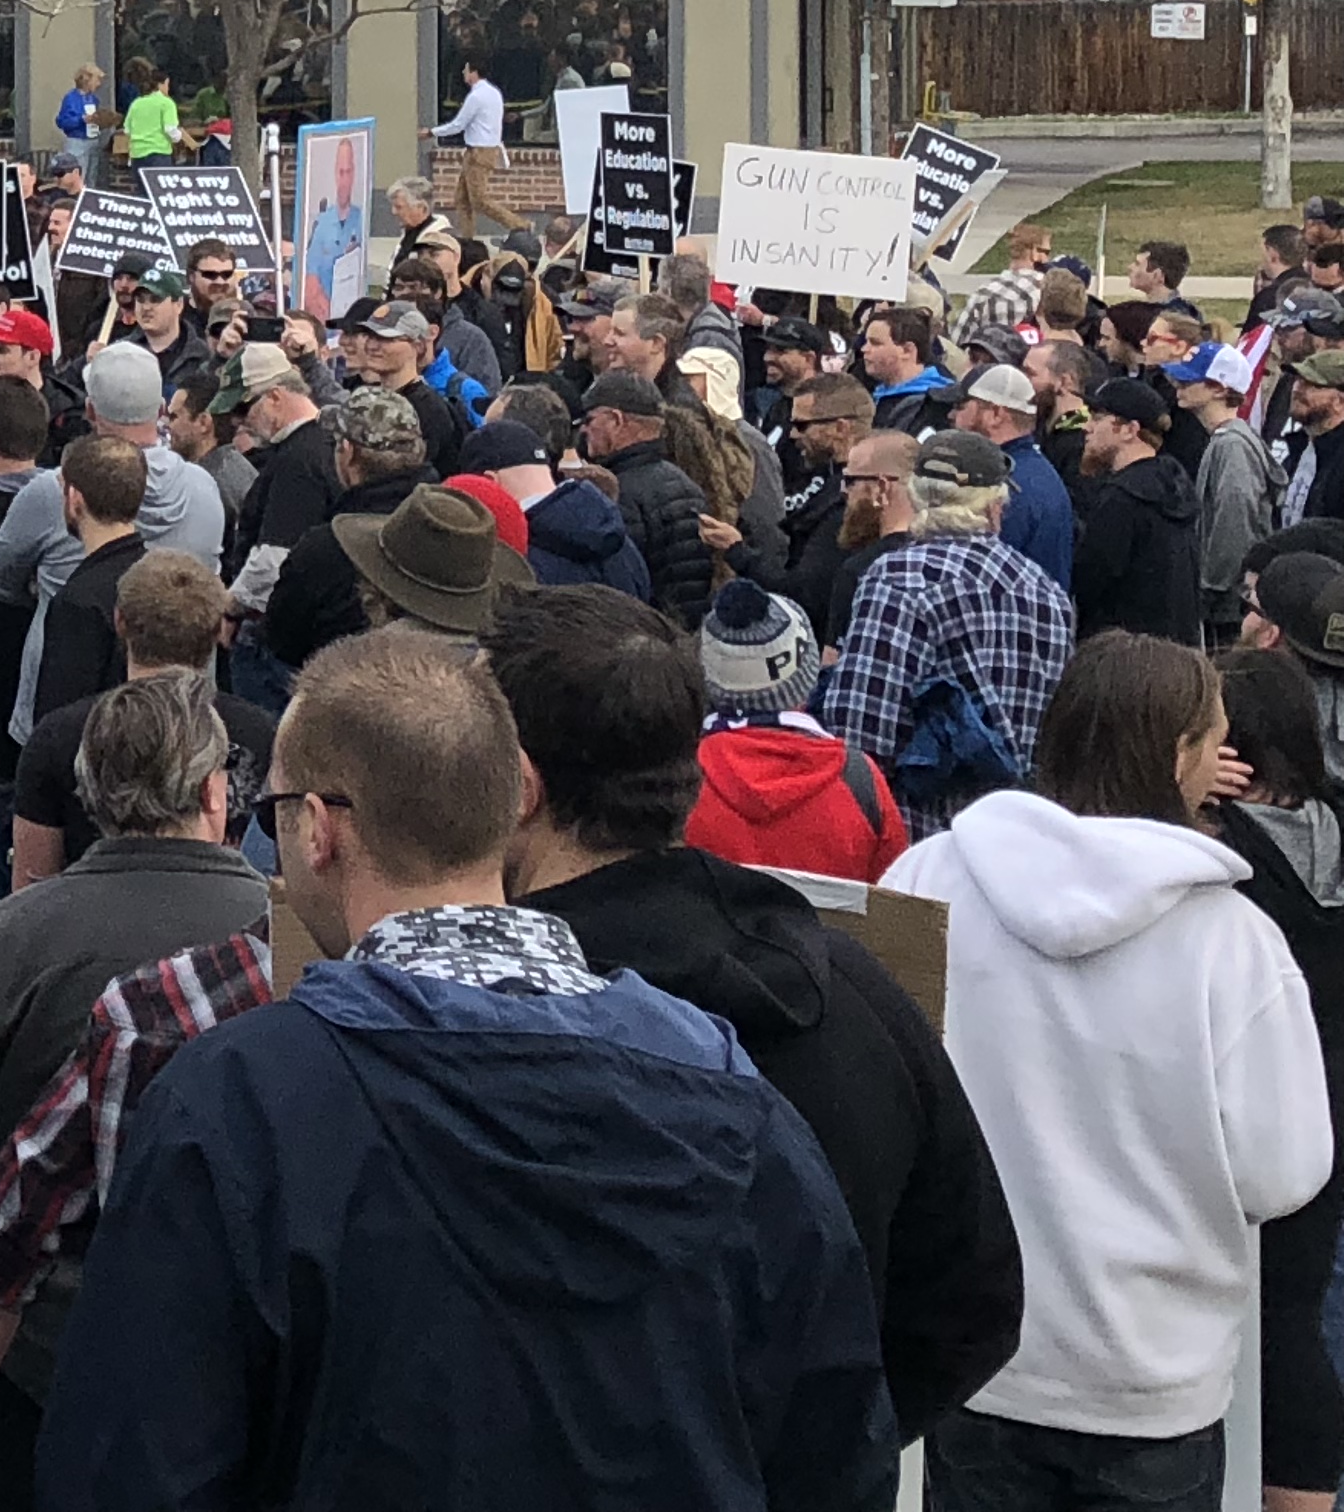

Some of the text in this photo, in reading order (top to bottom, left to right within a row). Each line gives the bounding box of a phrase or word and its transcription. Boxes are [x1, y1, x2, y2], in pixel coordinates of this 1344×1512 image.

[613, 120, 656, 143] More
[604, 149, 667, 173] Education
[925, 138, 977, 171] More
[157, 174, 230, 191] It's my
[735, 156, 907, 202] GUN CONTROL
[909, 155, 971, 194] ducatio
[158, 192, 240, 209] right to
[624, 182, 650, 200] vs.
[918, 187, 945, 210] vs.
[97, 197, 146, 218] There
[607, 206, 670, 231] Regulation
[802, 202, 841, 234] IS
[79, 211, 138, 233] Greater
[164, 210, 226, 227] defend
[226, 213, 254, 228] my
[75, 226, 112, 245] than
[66, 244, 124, 263] protect
